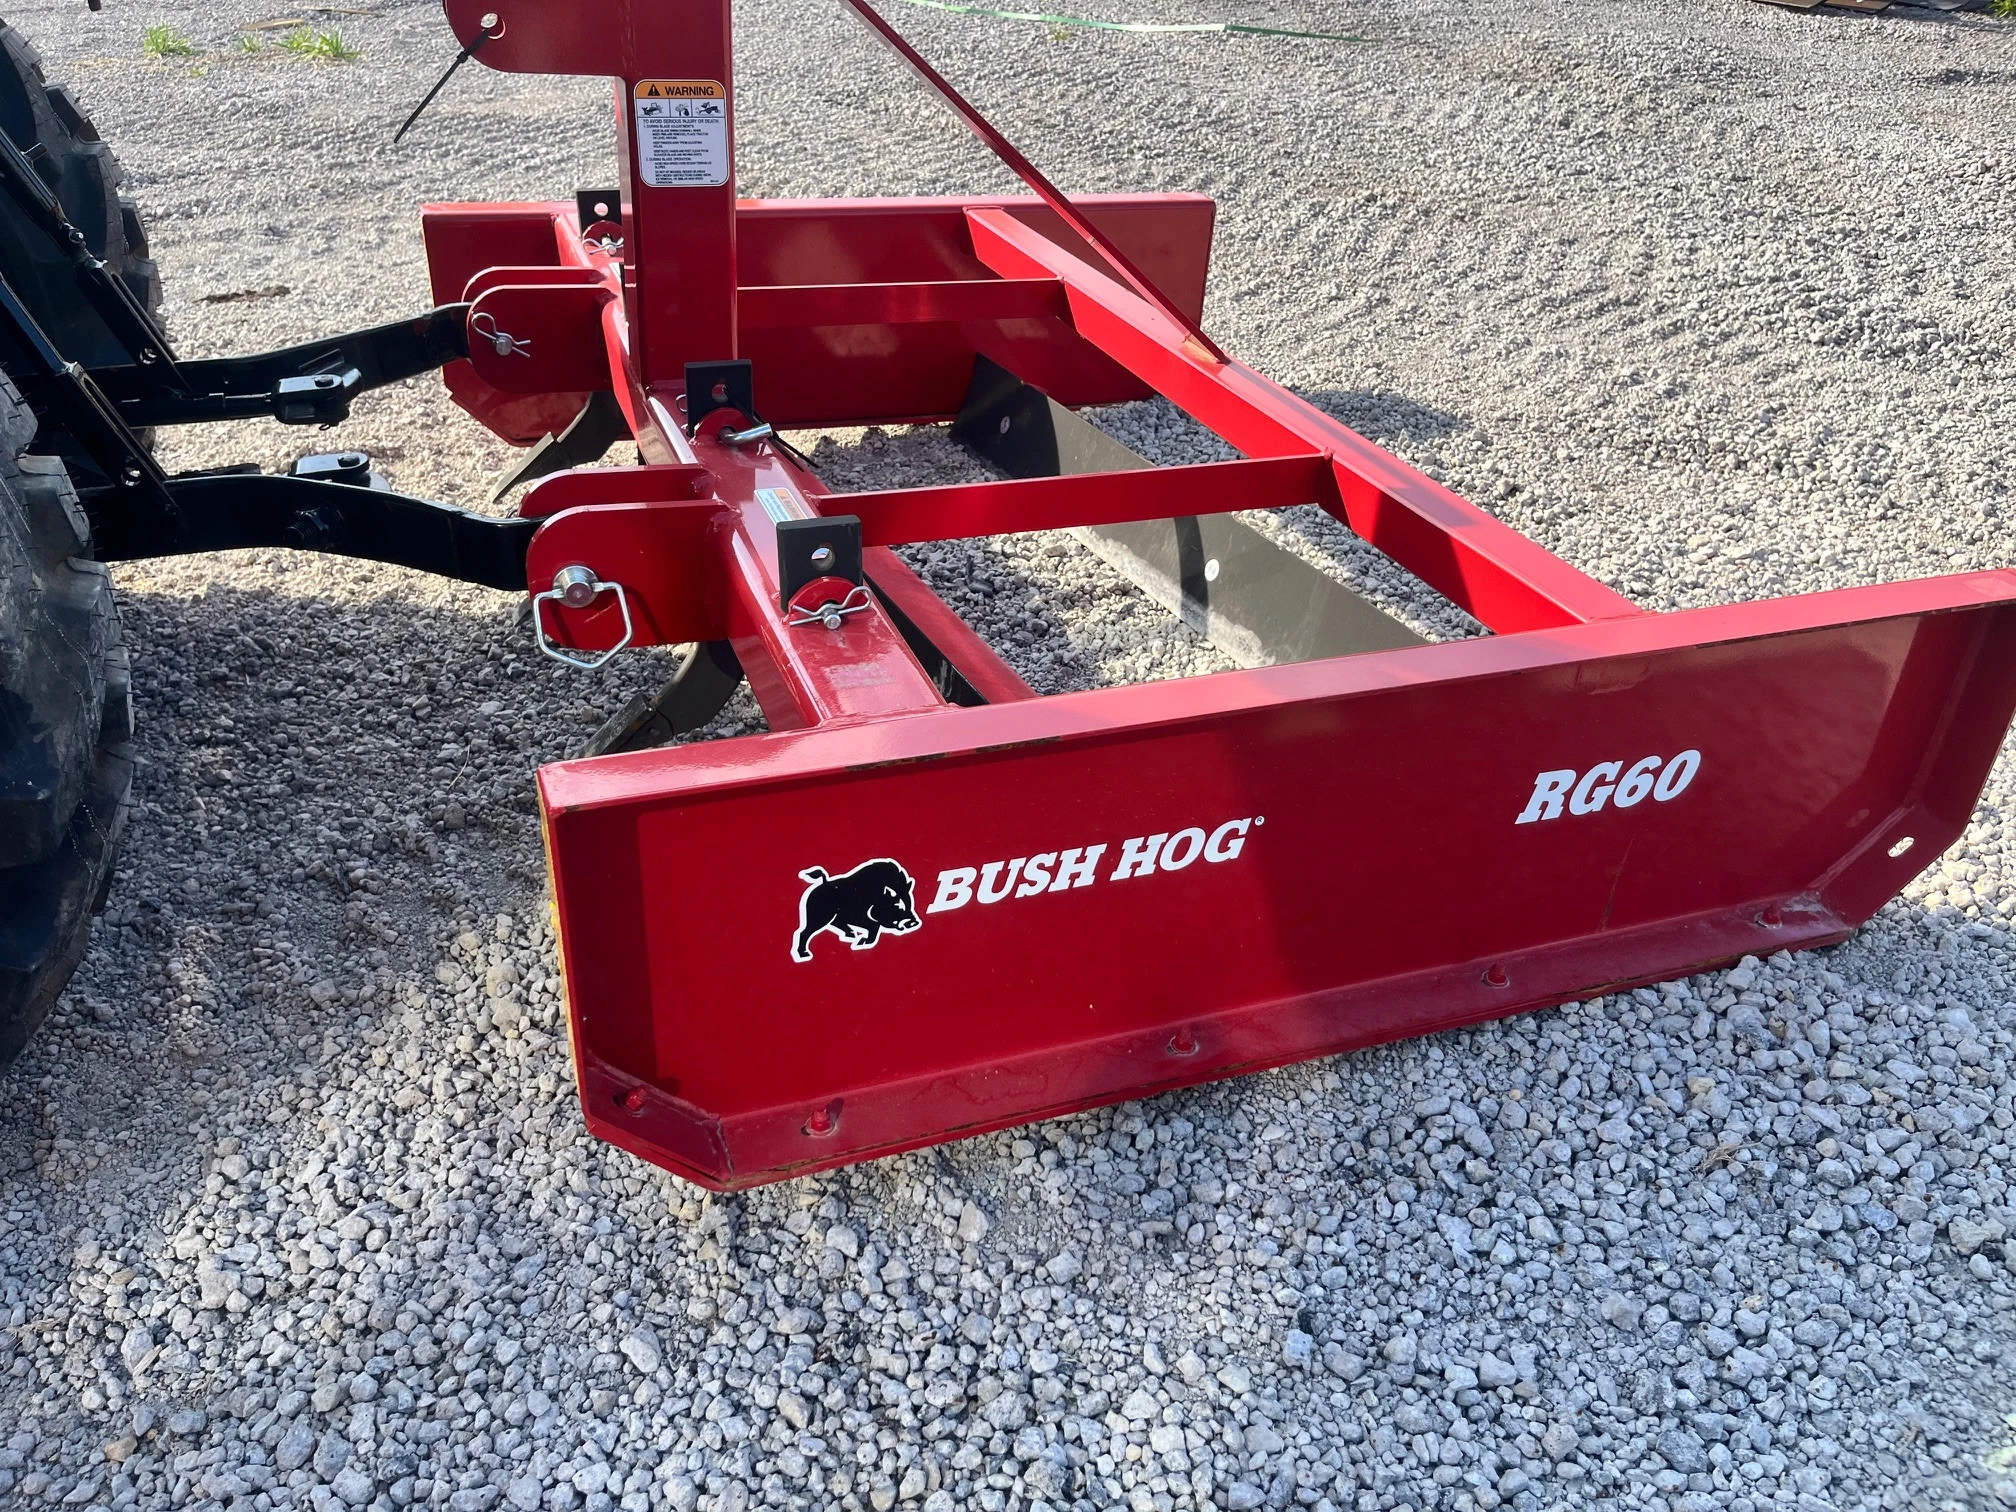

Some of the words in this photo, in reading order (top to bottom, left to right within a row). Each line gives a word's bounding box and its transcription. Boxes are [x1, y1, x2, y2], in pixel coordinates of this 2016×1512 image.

[665, 86, 714, 96] WARNING
[1514, 749, 1701, 825] RG60
[926, 843, 1107, 914] BUSH
